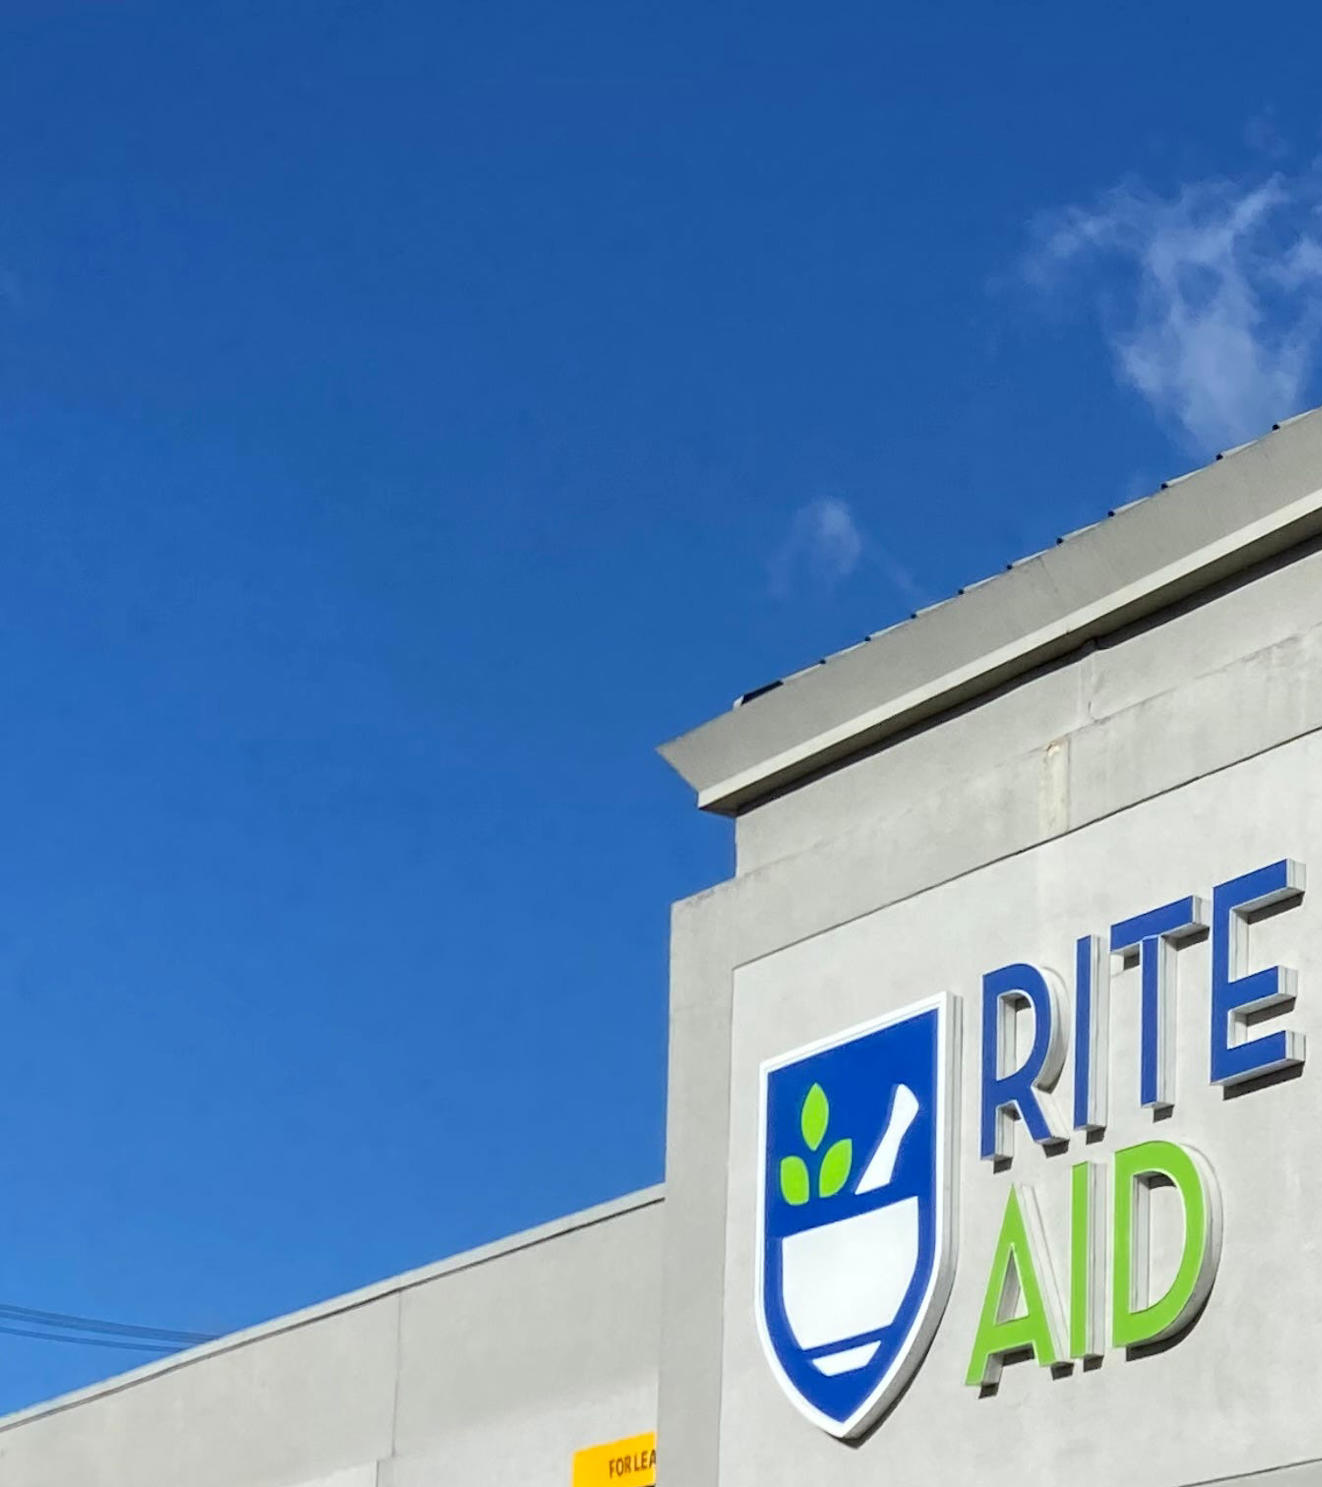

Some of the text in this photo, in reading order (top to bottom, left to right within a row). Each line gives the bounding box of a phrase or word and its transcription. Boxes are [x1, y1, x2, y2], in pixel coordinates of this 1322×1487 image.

[979, 858, 1305, 1170] RITE
[965, 1140, 1224, 1392] AID
[608, 1455, 632, 1479] FOR
